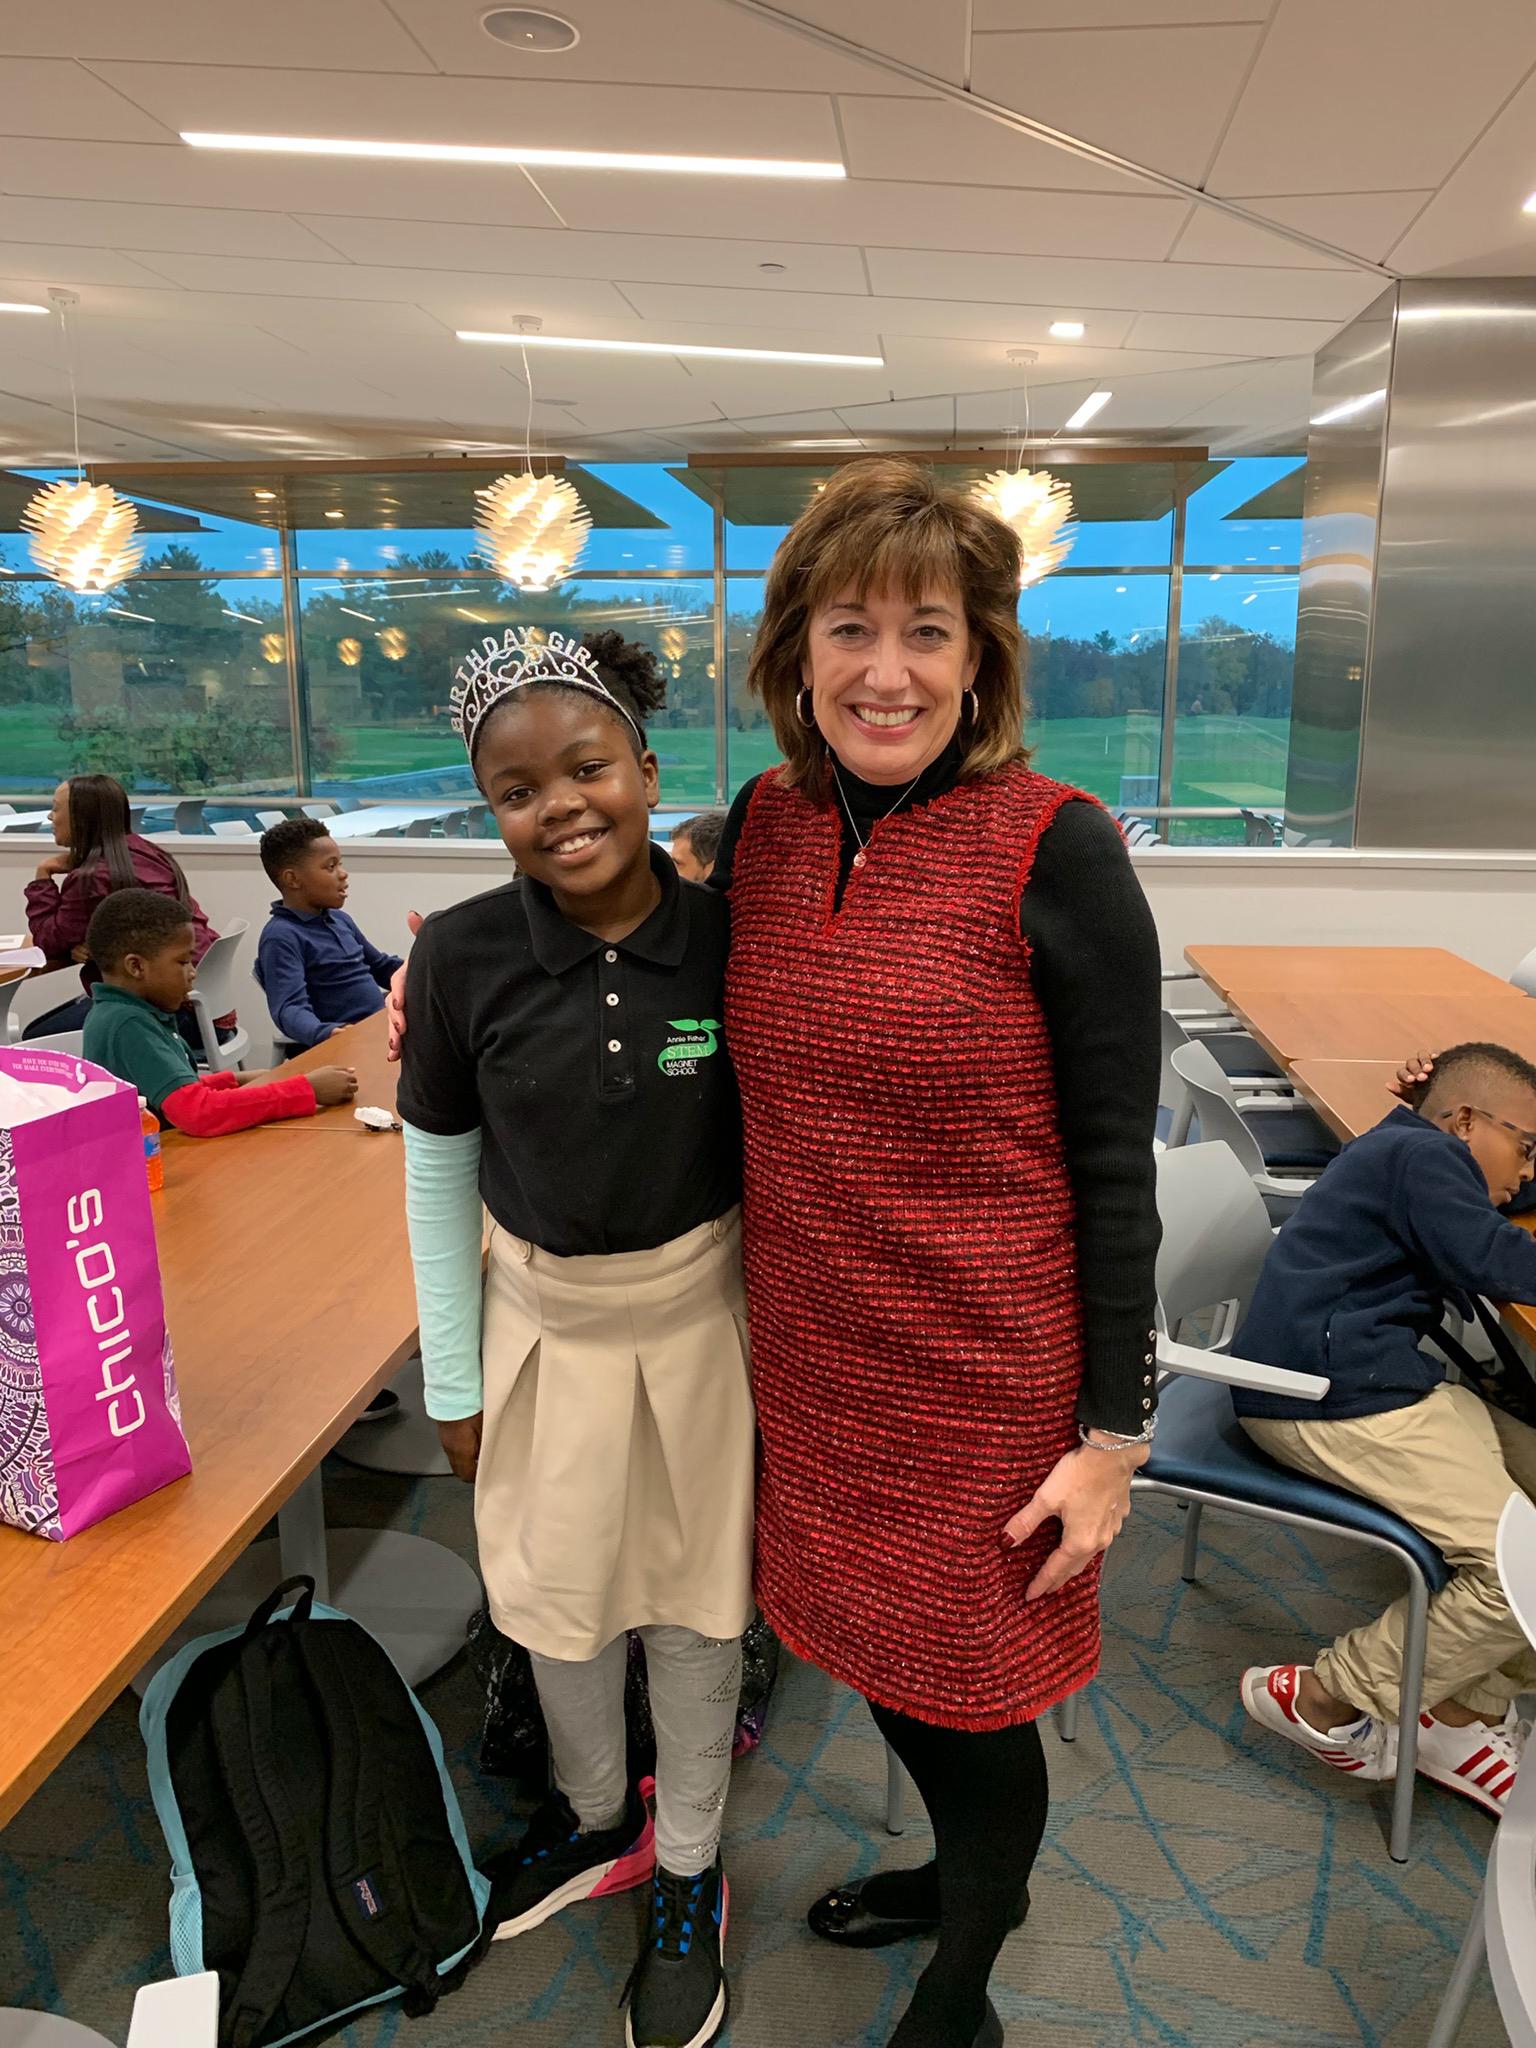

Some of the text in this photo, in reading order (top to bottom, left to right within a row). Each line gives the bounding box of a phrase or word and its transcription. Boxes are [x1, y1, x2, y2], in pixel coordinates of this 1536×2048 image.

[448, 626, 600, 733] BIRTHDAY GIRL
[667, 1045, 709, 1060] STEM
[666, 1059, 698, 1068] MAGNET
[667, 1067, 698, 1076] SCHOOL
